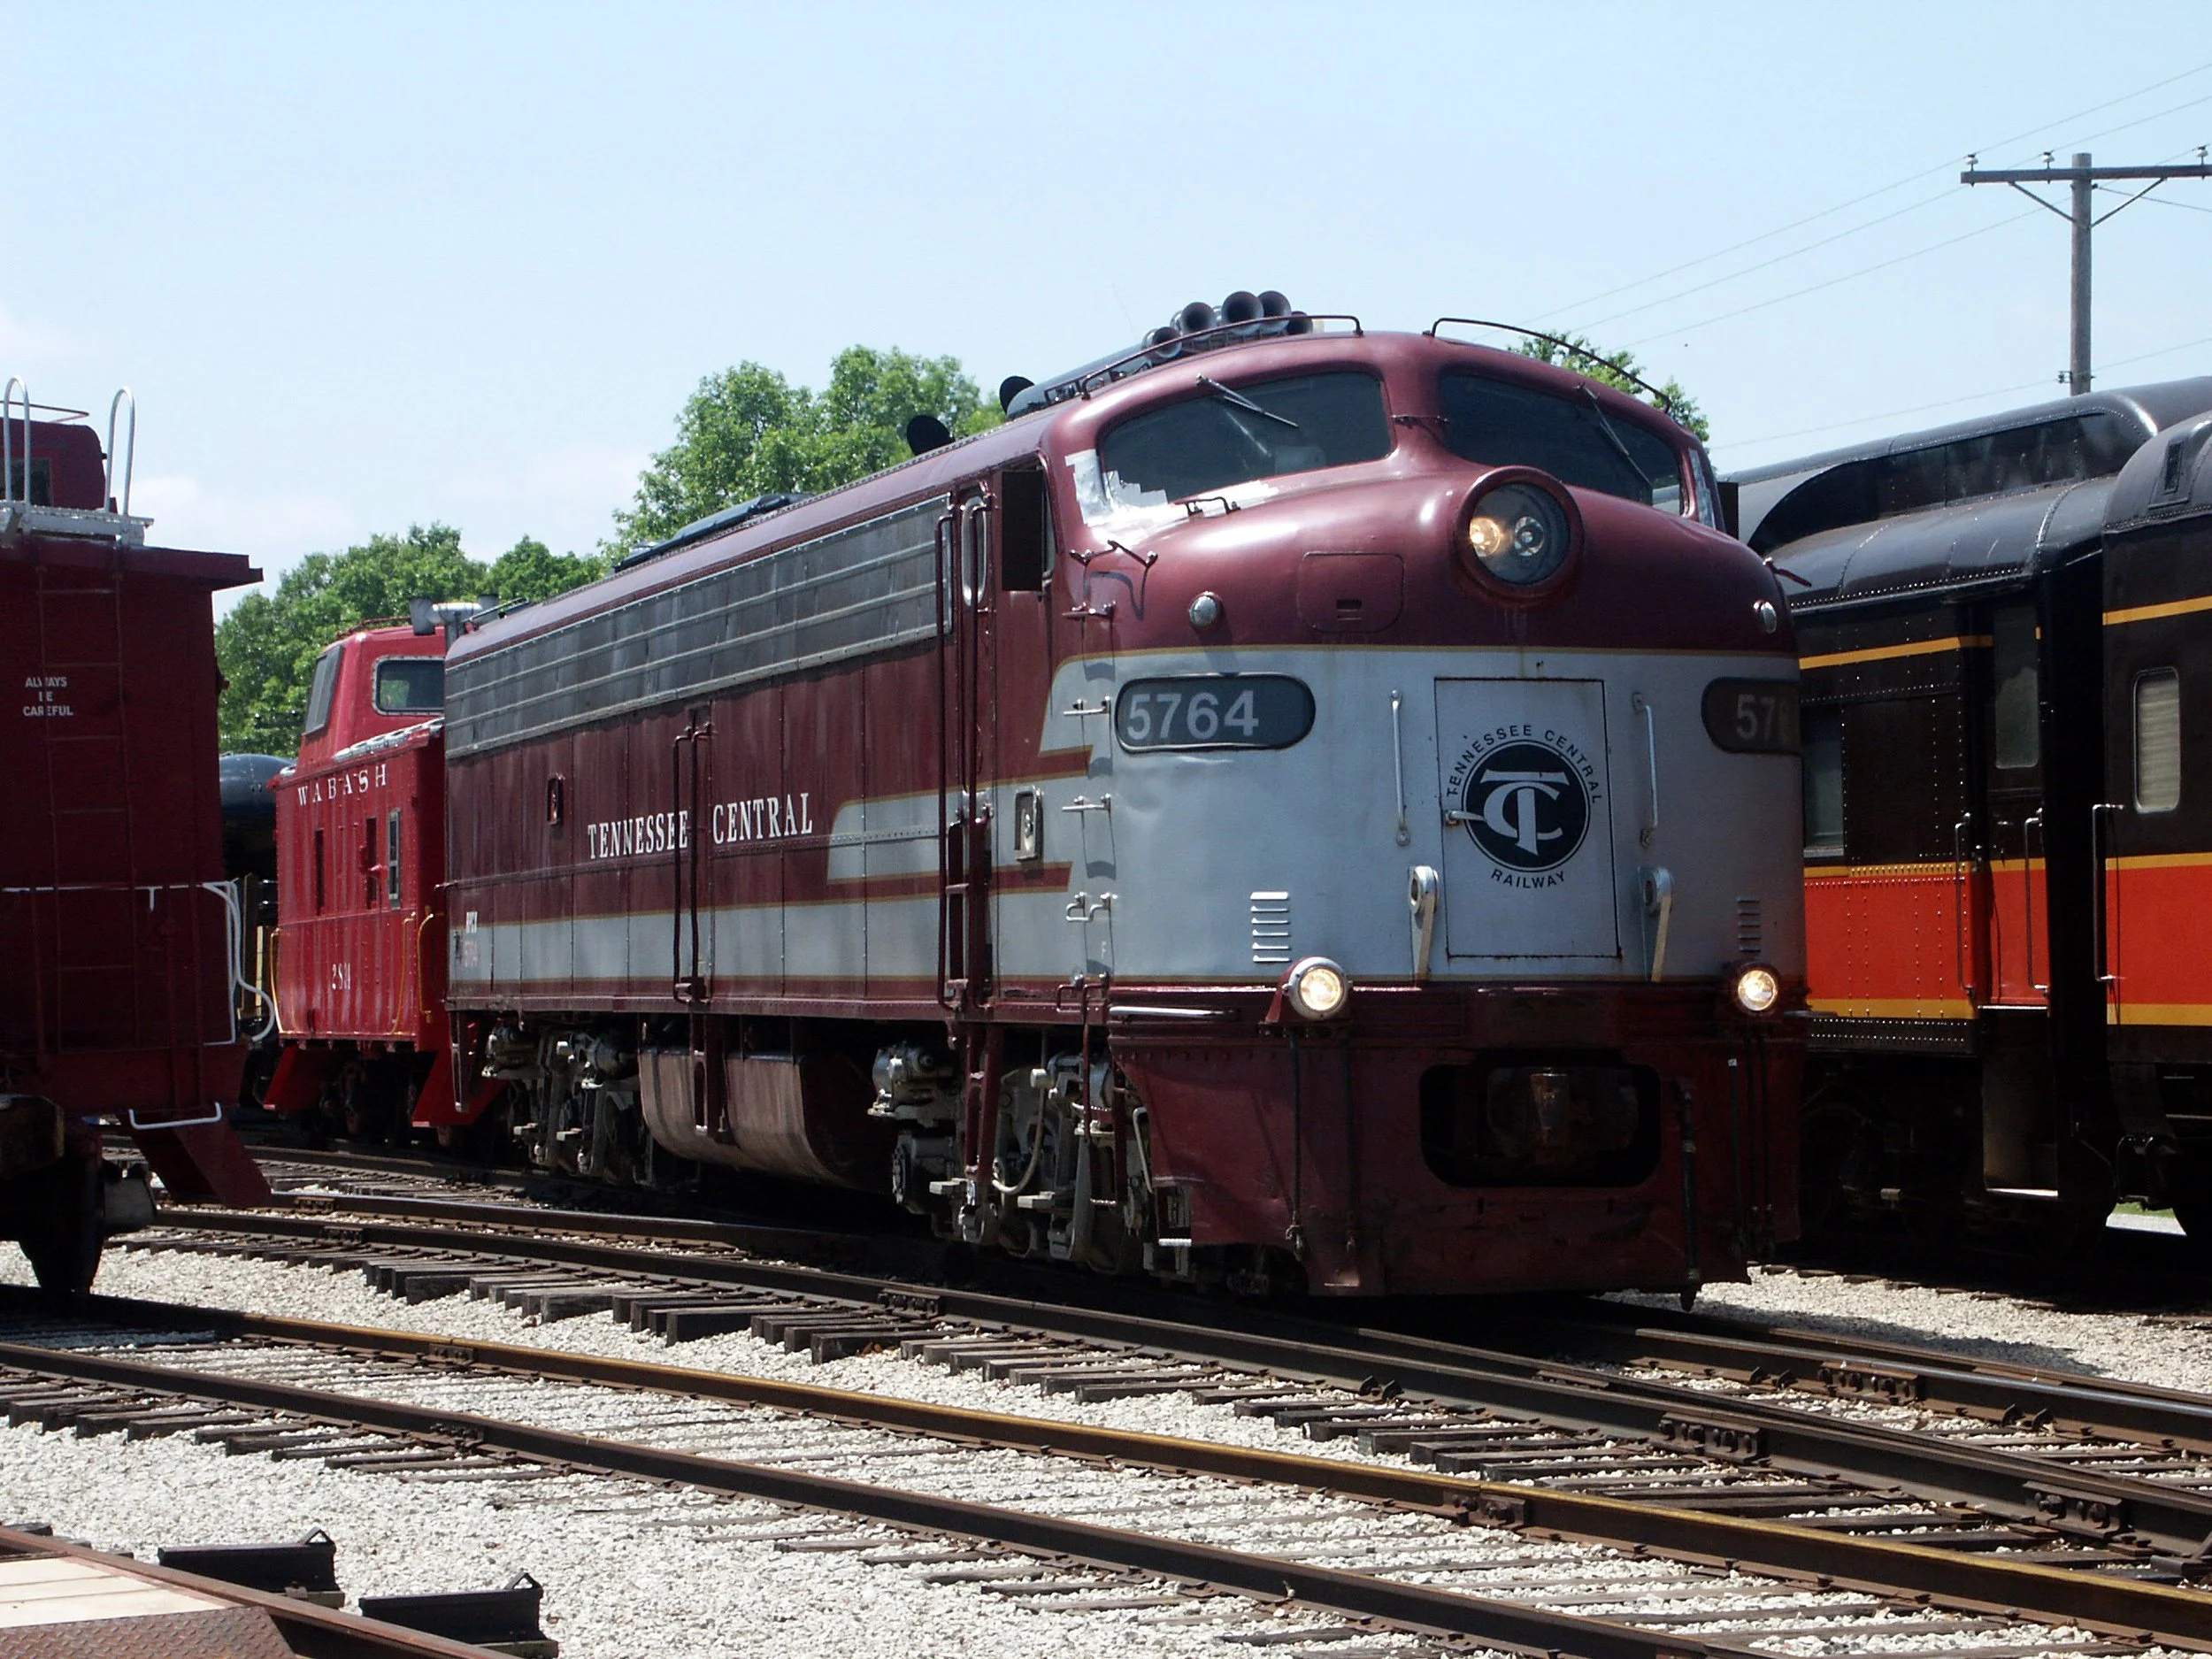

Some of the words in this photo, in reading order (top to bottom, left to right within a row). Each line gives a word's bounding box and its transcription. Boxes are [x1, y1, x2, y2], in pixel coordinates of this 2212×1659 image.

[23, 705, 73, 716] CAREFUL
[1126, 690, 1259, 740] 5764
[298, 764, 387, 806] WABASH
[1447, 725, 1532, 797] TENNESSEE
[1545, 729, 1602, 804] CENTRAL
[588, 810, 687, 859] TENNESSEE
[712, 793, 813, 845] CENTRAL
[1491, 868, 1566, 889] RAILWAY
